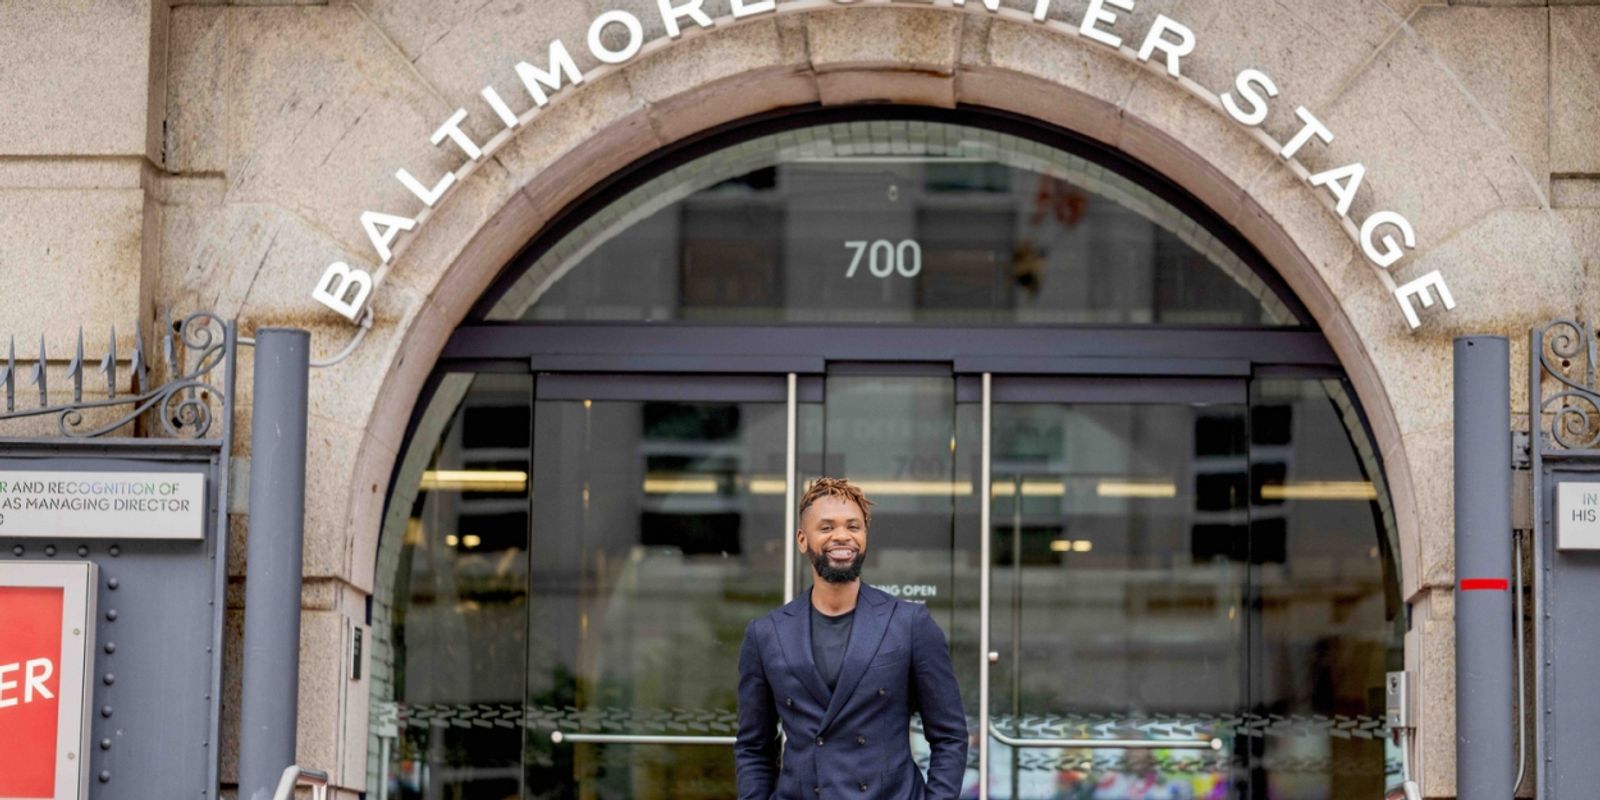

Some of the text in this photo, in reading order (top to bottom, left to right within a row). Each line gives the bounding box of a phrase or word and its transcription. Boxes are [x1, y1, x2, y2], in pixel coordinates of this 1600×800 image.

[1218, 68, 1457, 330] STAGE
[844, 239, 922, 279] 700
[11, 481, 45, 494] AND
[48, 481, 156, 495] RECOGNITION
[159, 482, 180, 495] OF
[2, 497, 190, 512] AS MANAGING DIRECTOR
[1583, 493, 1598, 505] IN
[1572, 509, 1597, 522] HIS
[902, 584, 937, 597] OPEN
[0, 657, 55, 708] ER
